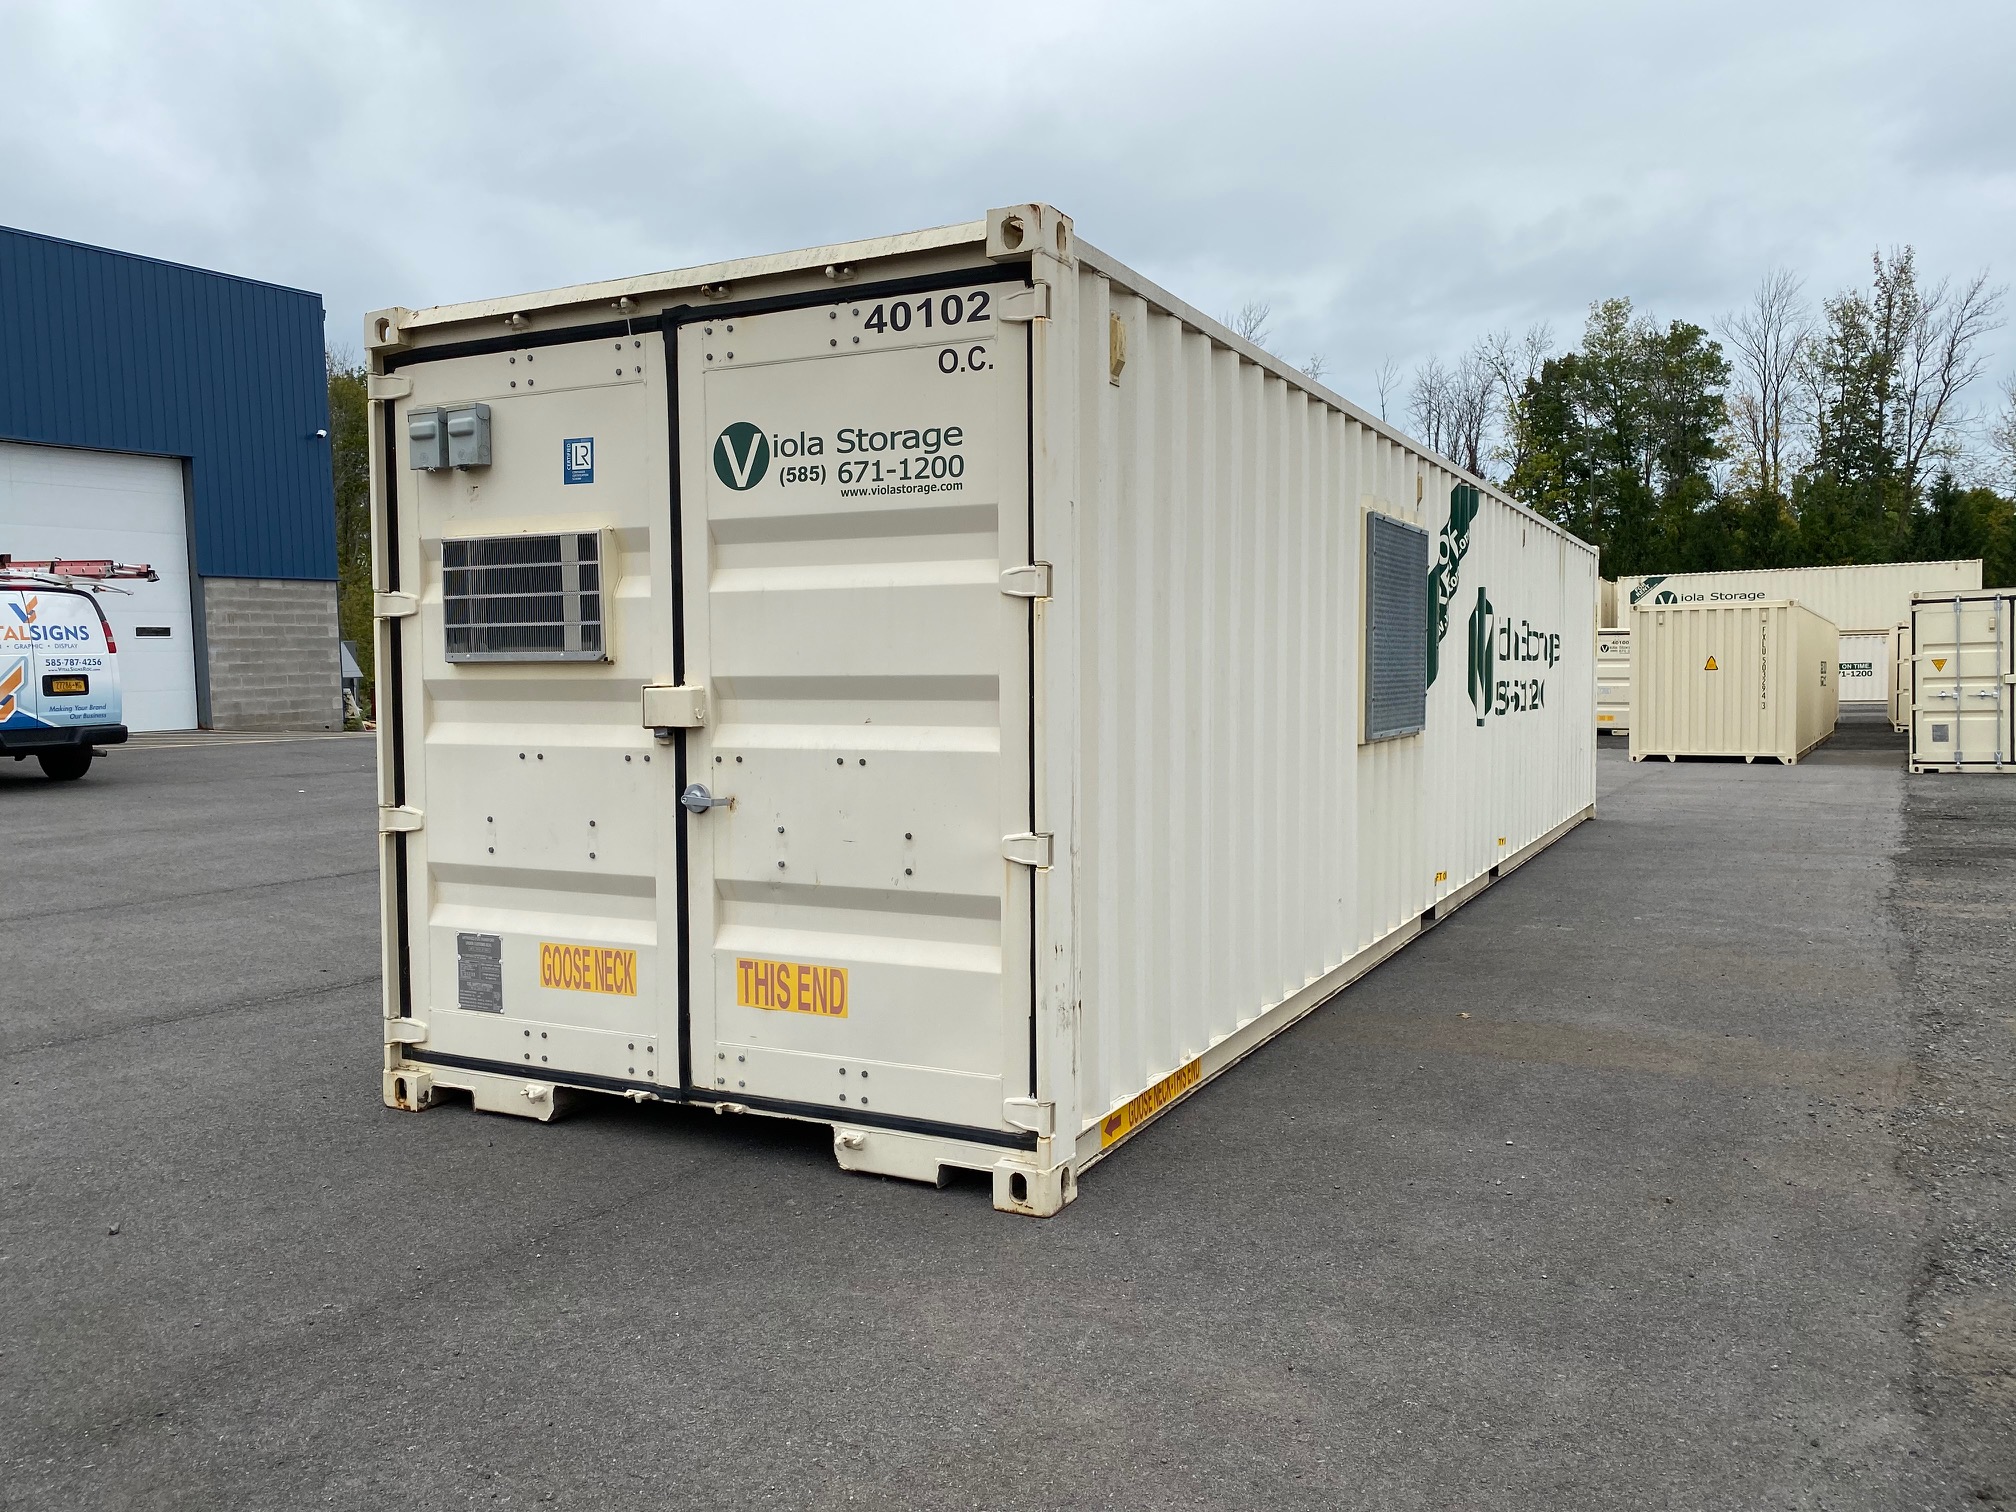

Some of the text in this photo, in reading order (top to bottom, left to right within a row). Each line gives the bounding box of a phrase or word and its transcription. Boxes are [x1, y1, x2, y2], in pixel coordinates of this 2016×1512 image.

[864, 290, 991, 334] 40102
[938, 345, 994, 374] O.C.
[836, 425, 964, 455] Storage
[575, 445, 589, 466] LR
[779, 454, 965, 487] (585) 671-1200
[840, 480, 963, 498] www.violastorage.com
[1710, 591, 1766, 602] Storage
[48, 705, 73, 713] Making
[541, 944, 592, 989] GOOSE
[594, 948, 635, 995] NECK
[738, 959, 846, 1015] THIS END
